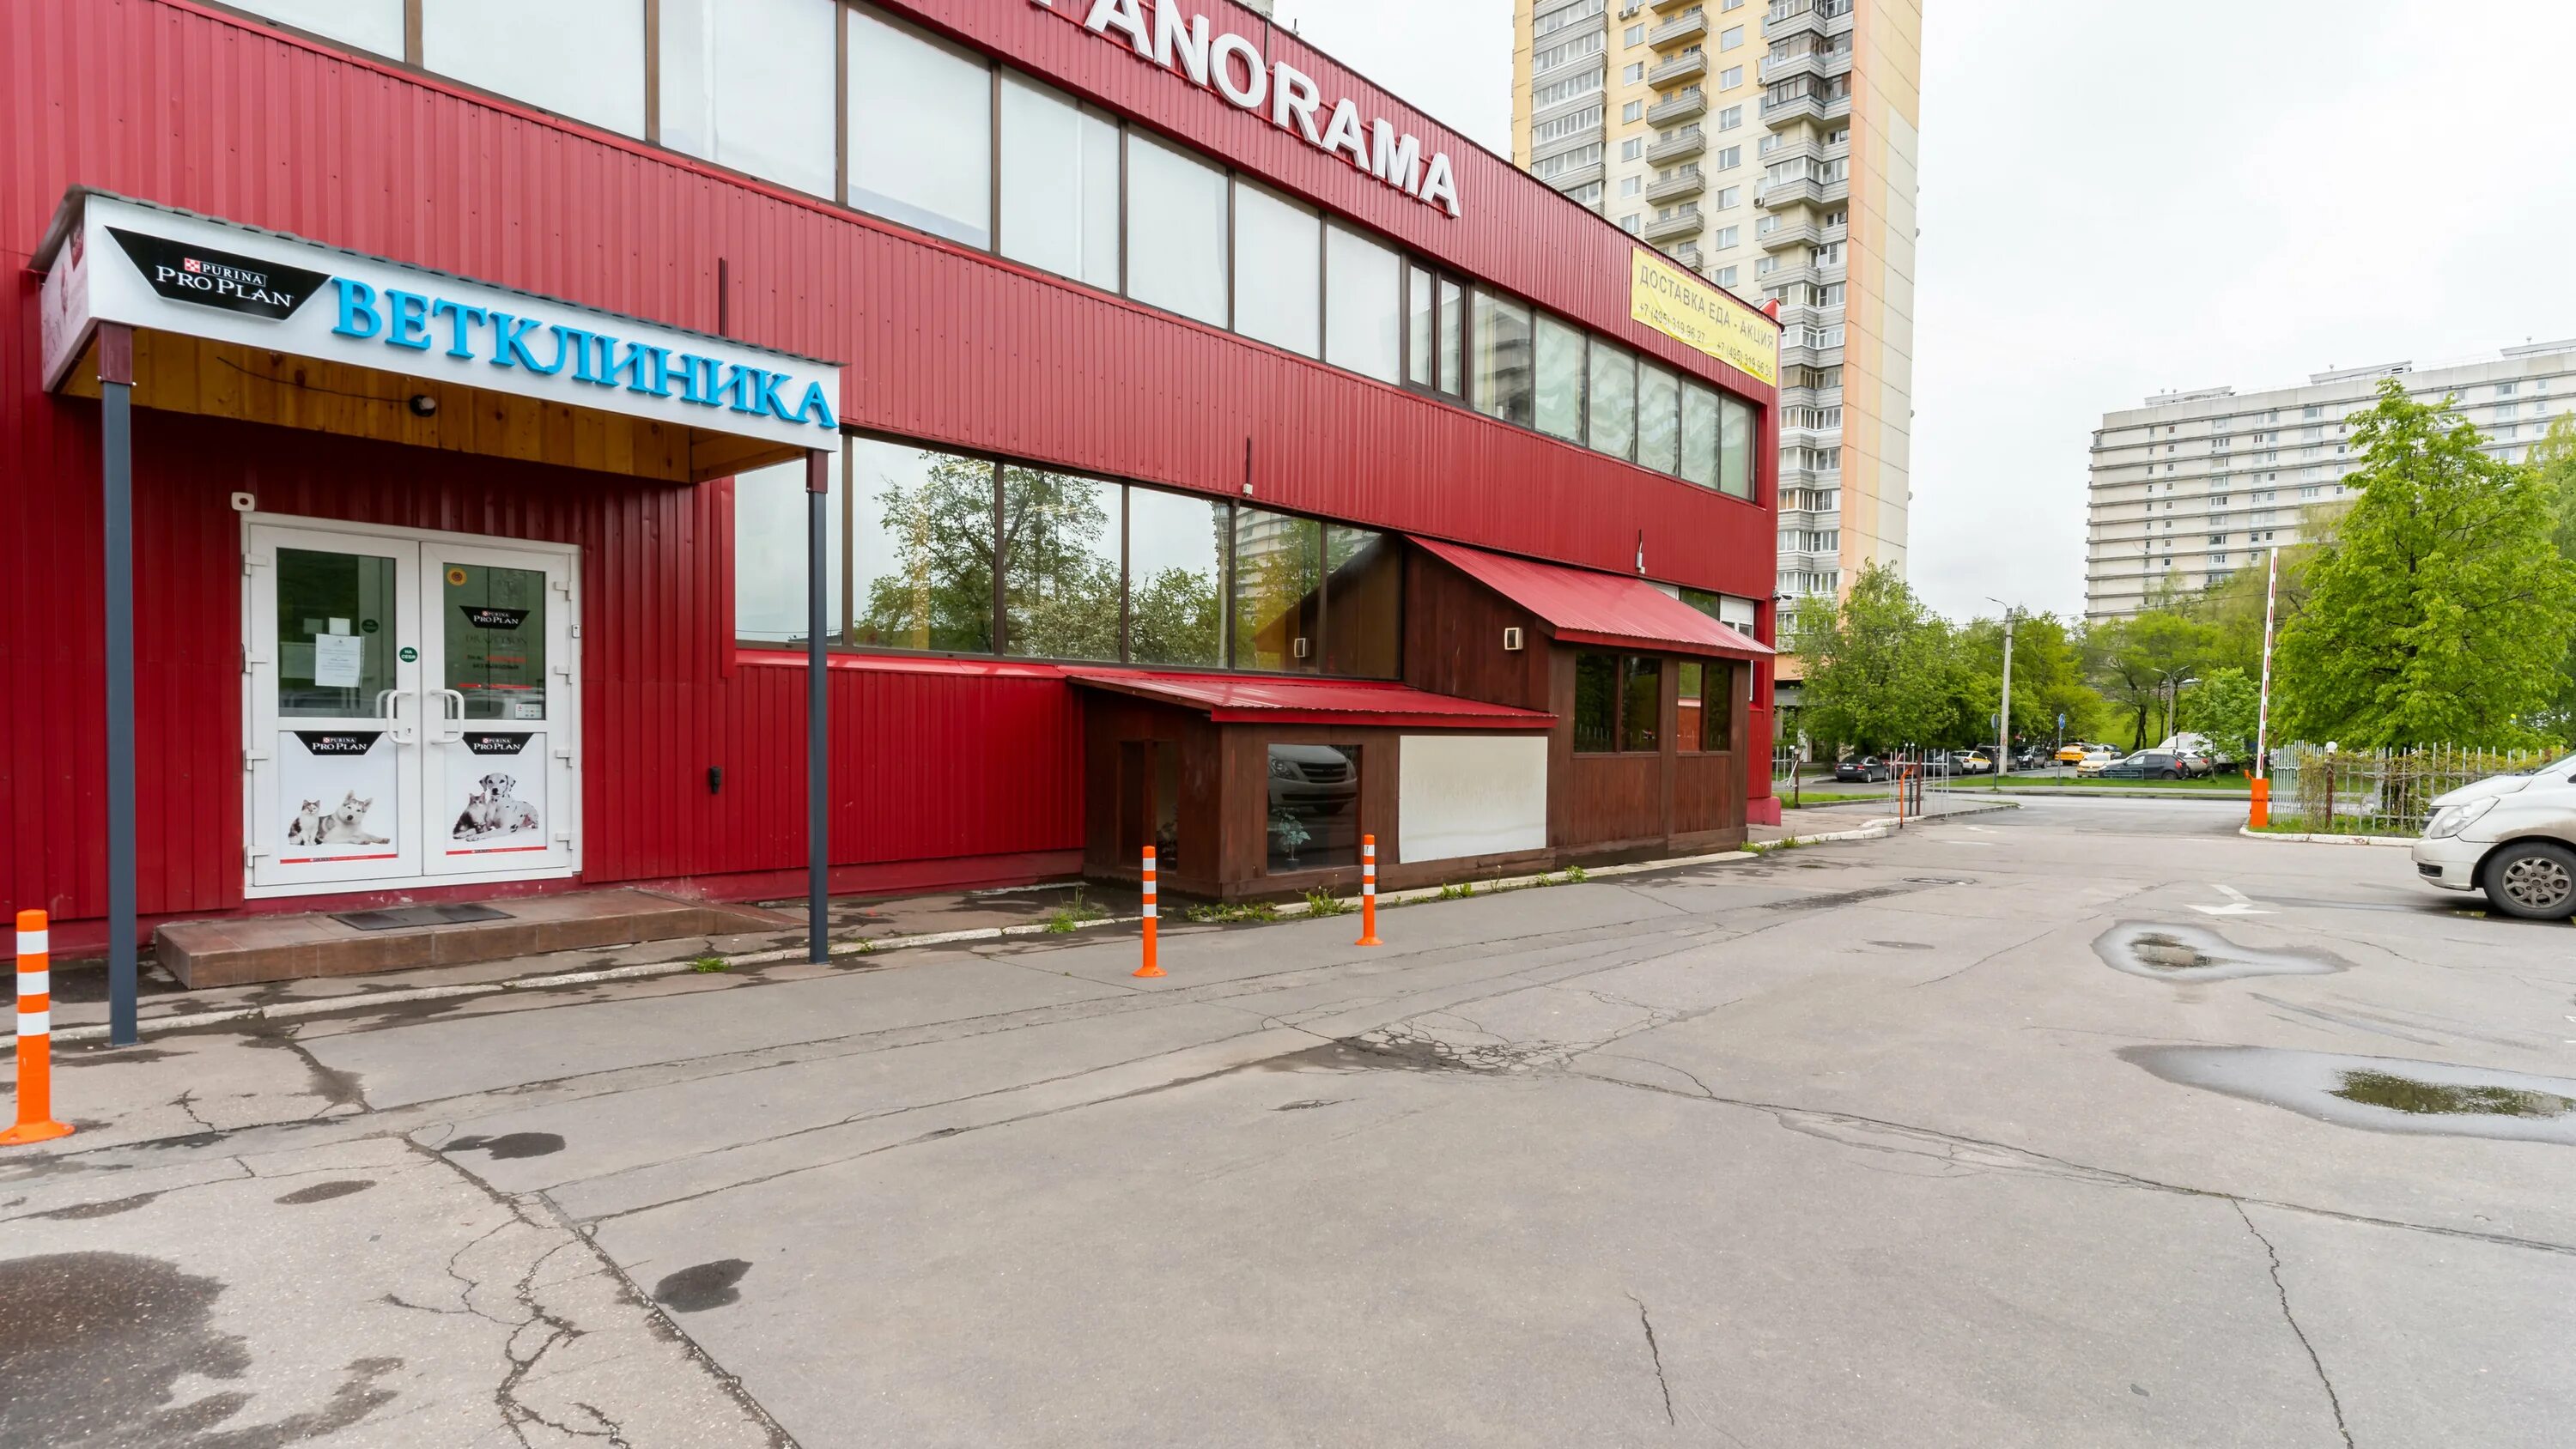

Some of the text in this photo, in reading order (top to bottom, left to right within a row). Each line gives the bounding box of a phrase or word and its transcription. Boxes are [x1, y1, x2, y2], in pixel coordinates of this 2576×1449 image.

[1031, 0, 1460, 218] ANORAMA
[155, 265, 294, 307] PRO PLAN
[203, 264, 263, 285] PURINA
[1639, 303, 1649, 317] +7
[1640, 265, 1705, 315] ДОСТАВКА
[1709, 302, 1730, 328] ЕДА
[1740, 320, 1774, 351] АКЦИЯ
[331, 276, 838, 429] ВЕТКЛИНИКА
[473, 615, 519, 625] PRO PLAN
